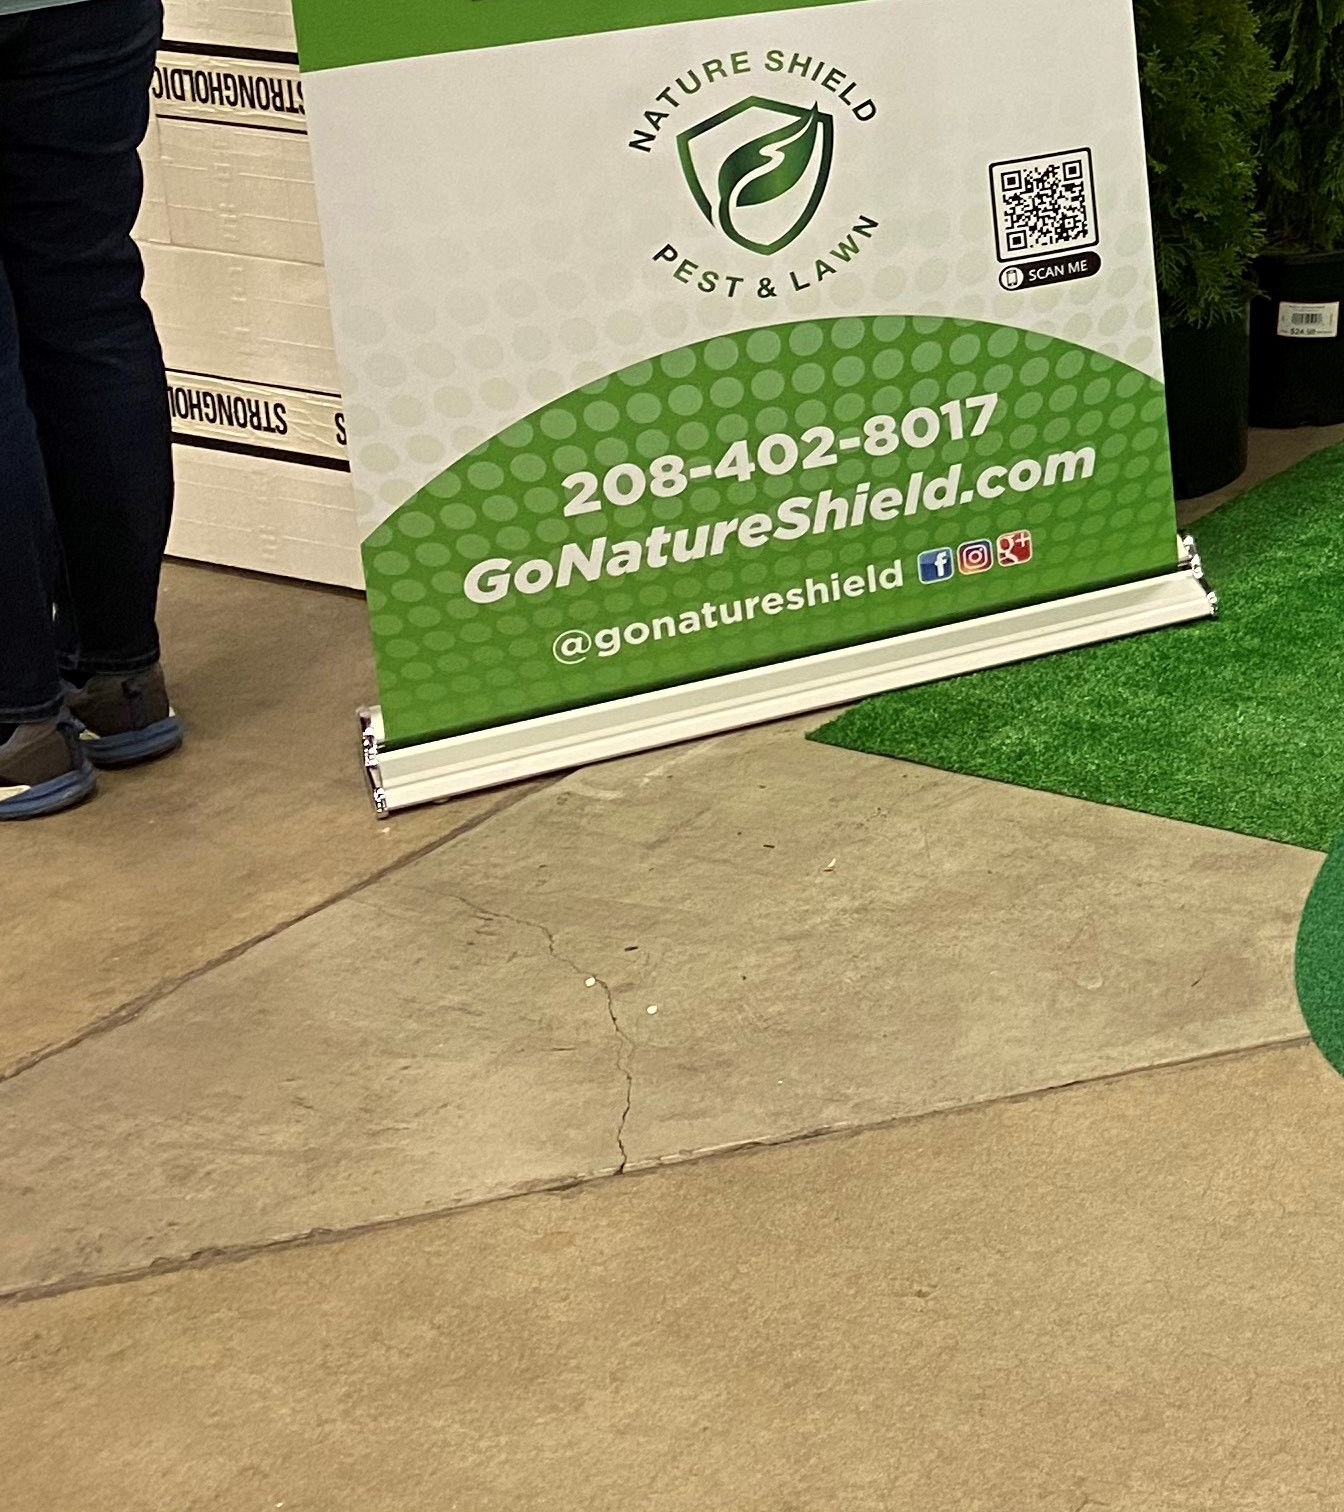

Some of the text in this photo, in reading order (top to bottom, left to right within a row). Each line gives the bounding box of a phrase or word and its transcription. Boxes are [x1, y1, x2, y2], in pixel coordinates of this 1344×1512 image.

[628, 49, 877, 152] NATURE SHIELD
[651, 214, 880, 298] PEST & LAWN
[1028, 258, 1088, 283] SCAN ME
[561, 393, 1000, 518] 208-402-8017
[462, 444, 1097, 605] GoNatureShield.com
[551, 560, 904, 665] @gonatureshield
